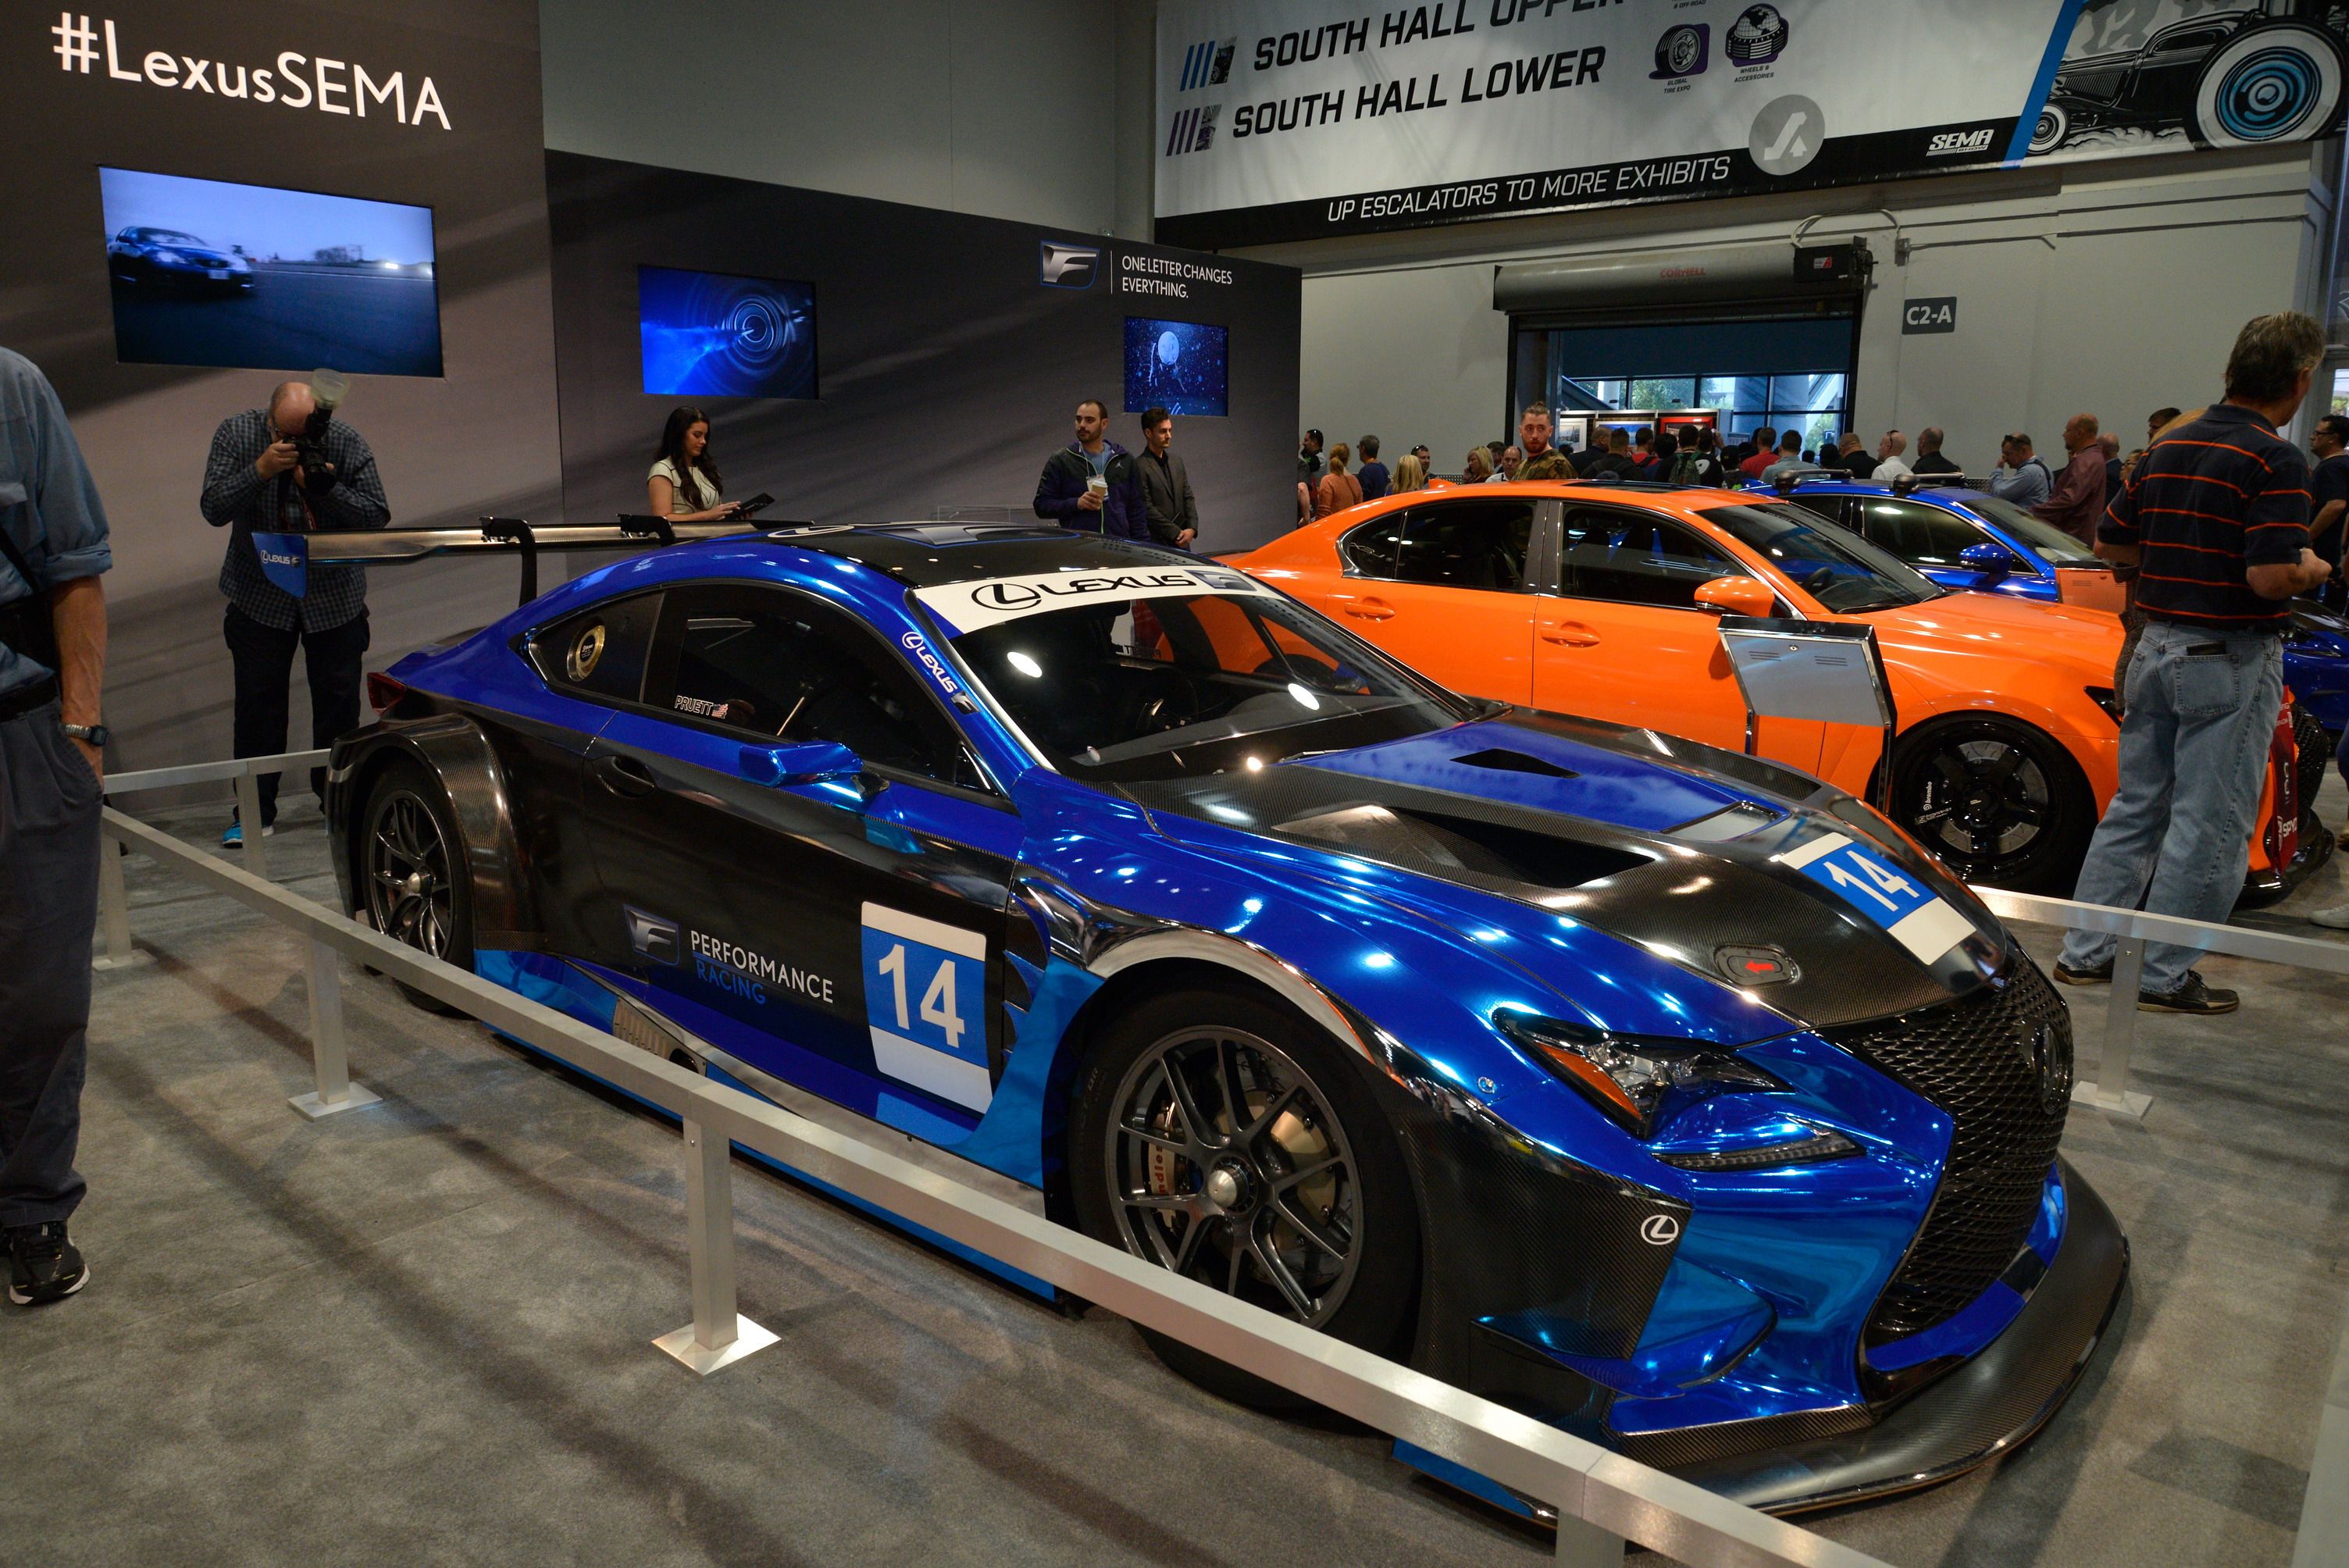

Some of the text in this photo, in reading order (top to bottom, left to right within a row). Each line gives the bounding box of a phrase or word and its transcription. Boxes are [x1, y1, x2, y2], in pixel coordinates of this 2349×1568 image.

[1253, 17, 1370, 71] SOUTH
[1379, 0, 1475, 48] HALL
[52, 12, 451, 130] #LexusSEMA
[1734, 72, 1775, 83] ACCESSORIES
[1740, 65, 1764, 73] WHEELS
[1232, 45, 1606, 138] SOUTH HALL LOWER
[1677, 84, 1691, 93] EXPO
[1929, 129, 1994, 151] SEMA
[1328, 156, 1731, 223] UP ESCALATORS TO MORE EXHIBITS
[1122, 255, 1232, 285] ONE LETTER CHANGES
[1122, 277, 1189, 299] EVERYTHING.
[1906, 305, 1952, 326] C2-A
[268, 554, 291, 565] LEXUS
[1036, 575, 1197, 596] LEXUS
[916, 647, 958, 693] LEXUS
[674, 695, 714, 716] PRUETT
[1823, 850, 1920, 912] 14
[690, 930, 834, 1004] PERFORMANCE
[696, 962, 767, 1006] RACING
[879, 943, 965, 1049] 14
